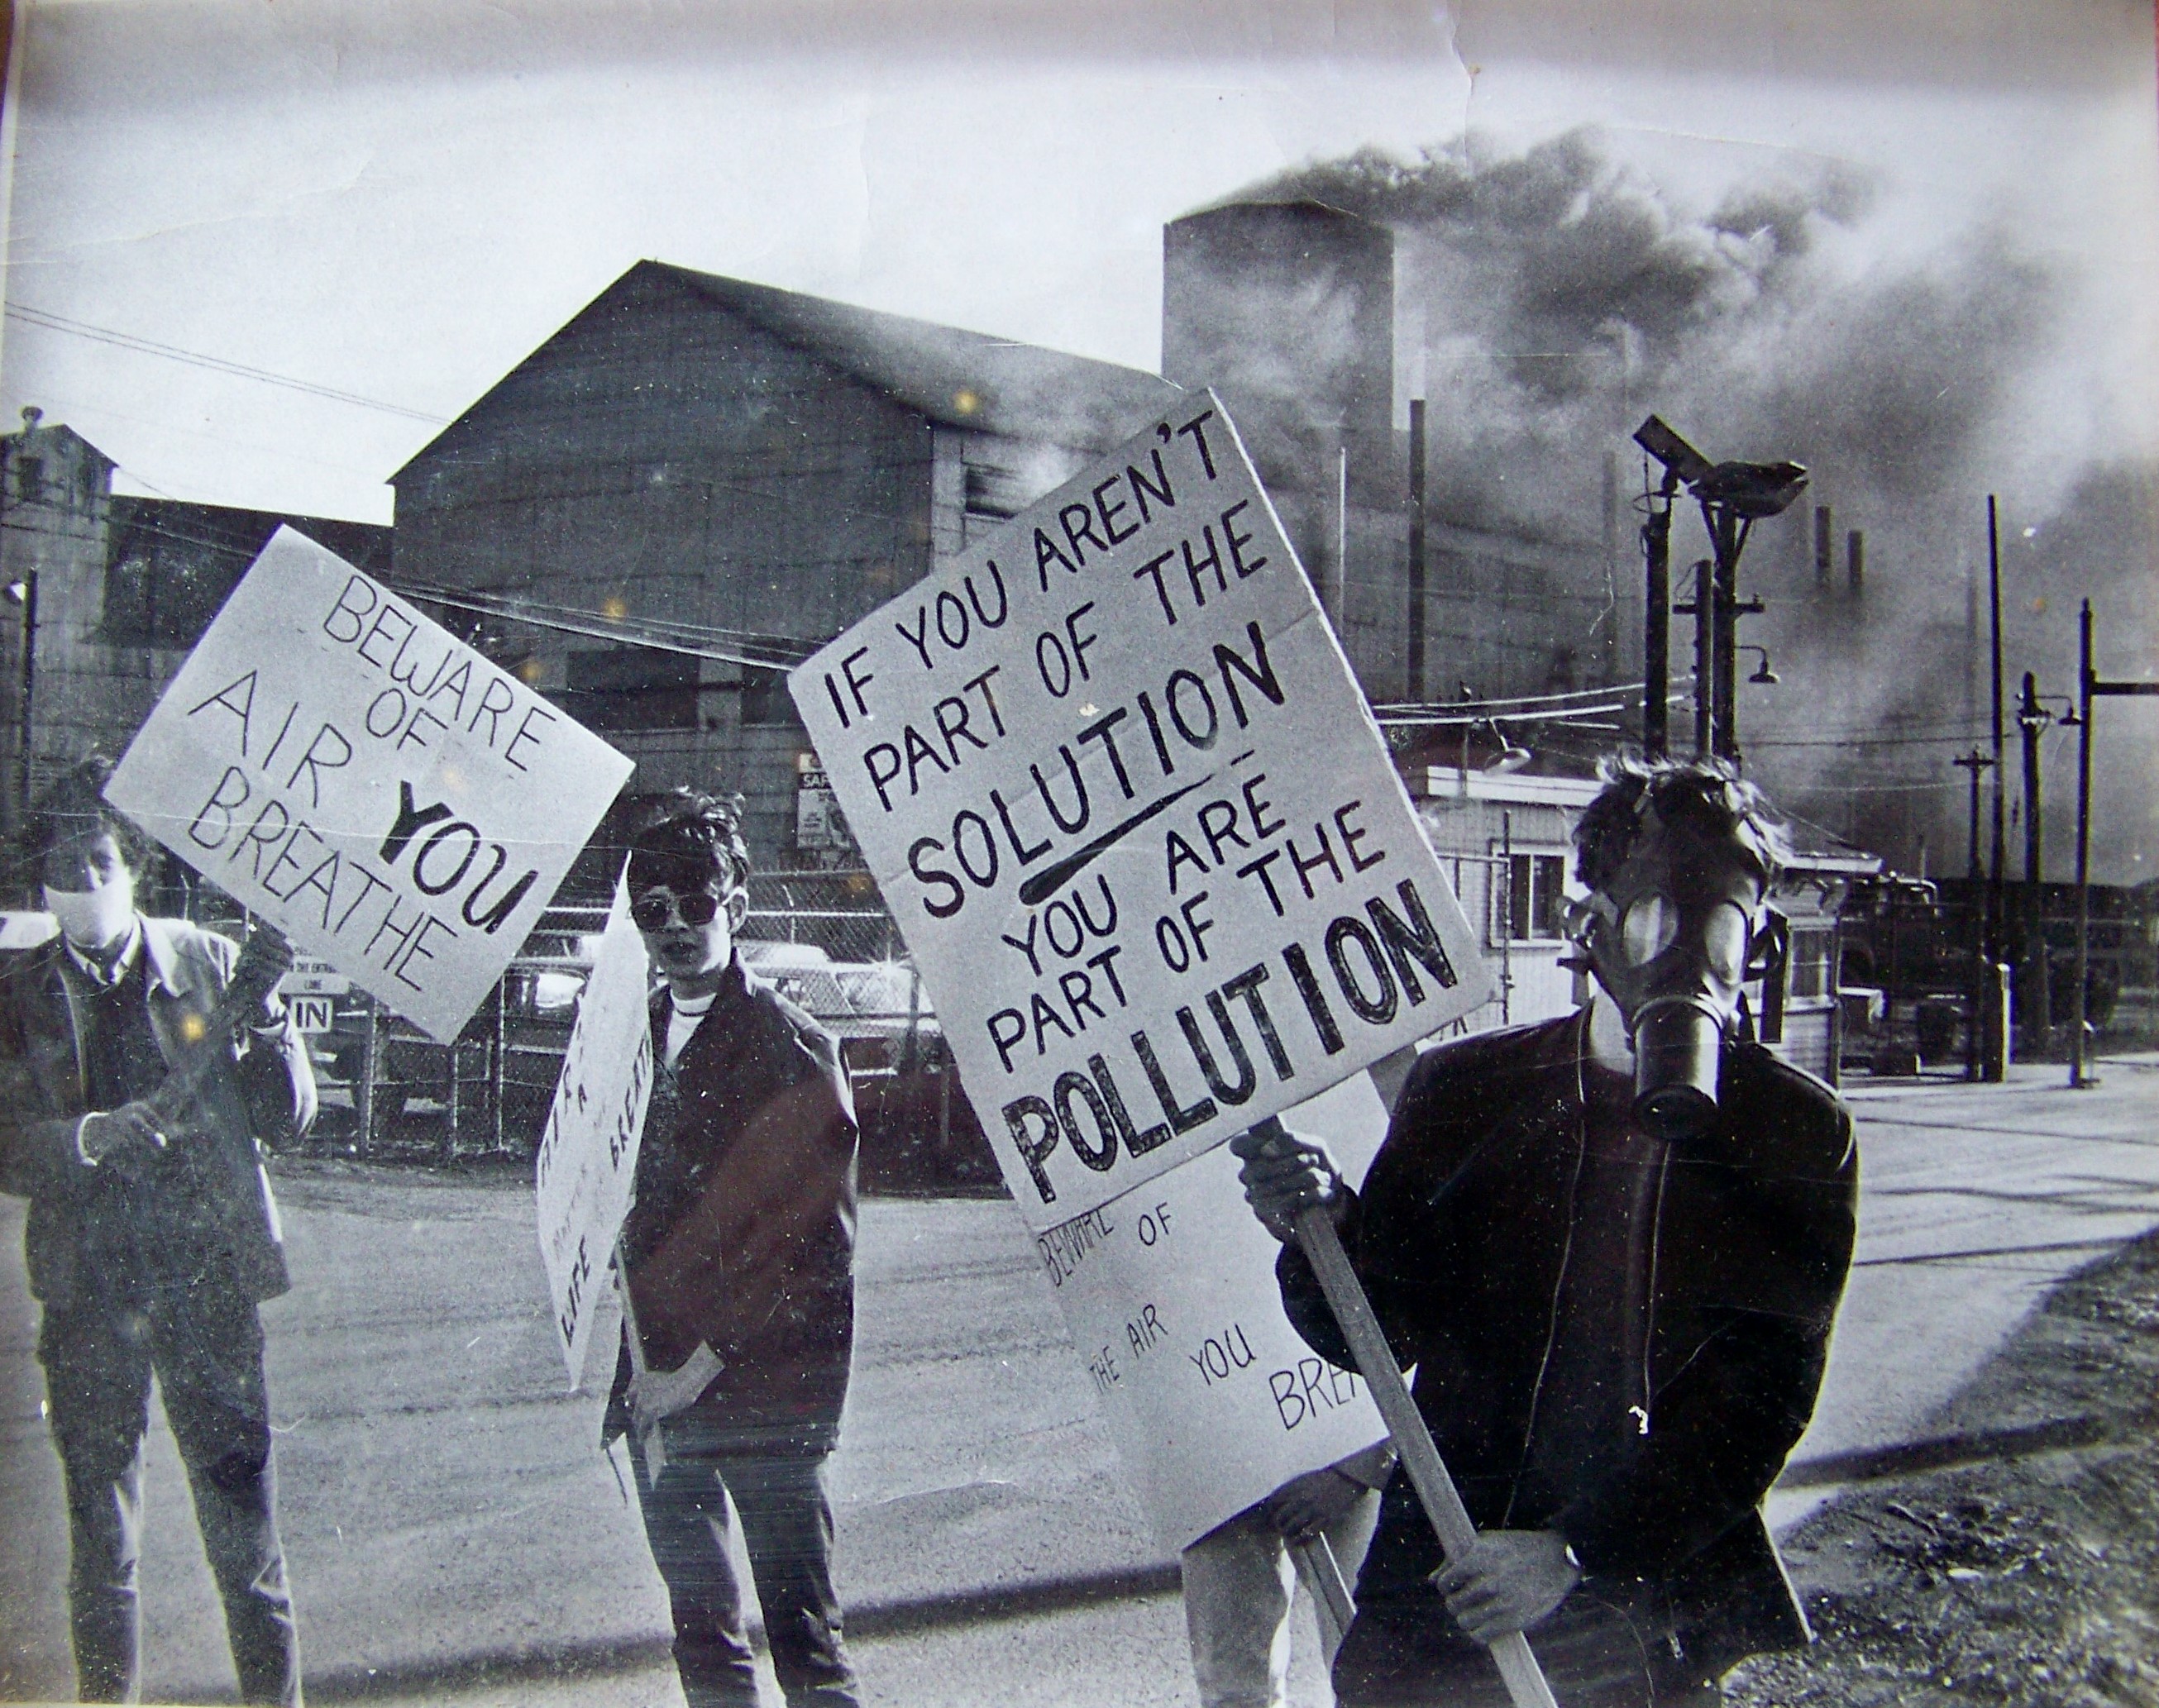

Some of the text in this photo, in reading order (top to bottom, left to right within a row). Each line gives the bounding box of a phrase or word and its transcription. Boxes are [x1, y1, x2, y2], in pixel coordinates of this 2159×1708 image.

[824, 410, 1216, 728] IF YOU AREN'T
[864, 500, 1267, 812] PART OF THE
[323, 575, 556, 771] BEWARE
[366, 689, 448, 751] OF
[909, 621, 1284, 917] SOLUTION
[188, 670, 539, 935] AIR YOU
[188, 766, 458, 991] BREATHE
[1001, 774, 1286, 976] YOU ARE
[296, 1001, 327, 1028] IN
[987, 800, 1385, 1072] PART OF THE
[1001, 878, 1457, 1203] POLLUTION
[561, 1234, 590, 1348] LIFE
[1139, 1202, 1171, 1246] OF
[1090, 1305, 1168, 1396] THE AIR
[1189, 1324, 1257, 1386] YOU
